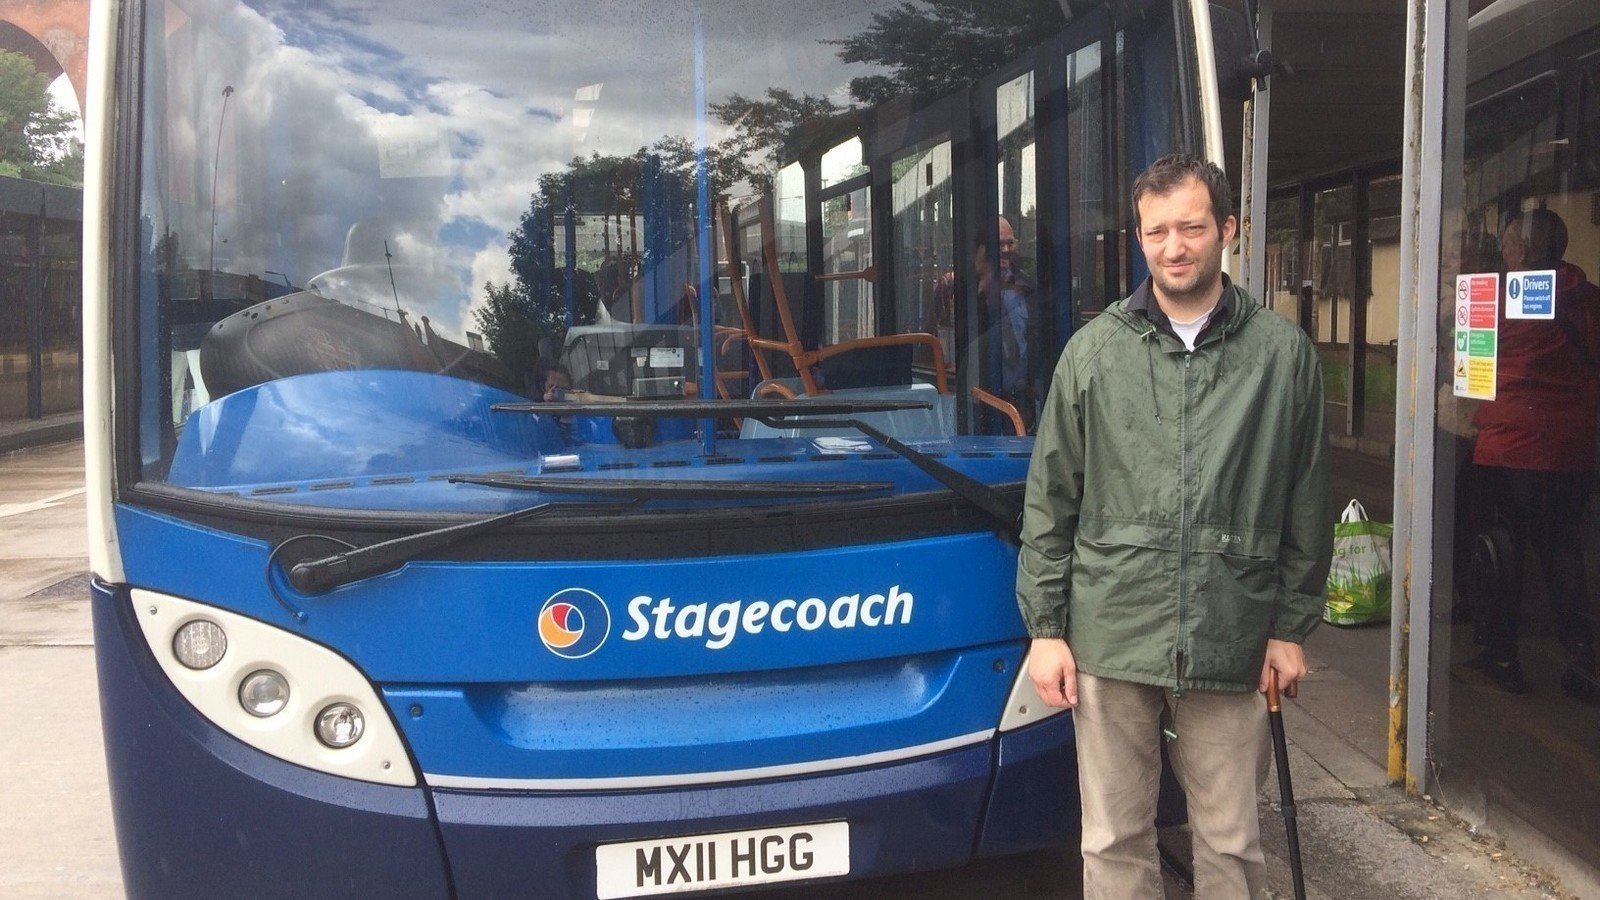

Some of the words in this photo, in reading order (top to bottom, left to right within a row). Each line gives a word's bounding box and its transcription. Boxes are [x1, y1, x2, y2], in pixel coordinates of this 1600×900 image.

[1524, 278, 1550, 290] Drivers
[1332, 547, 1346, 559] ag
[1350, 544, 1366, 554] for
[622, 585, 914, 650] Stagecoach
[636, 842, 717, 888] MX11
[731, 832, 814, 878] HGG
